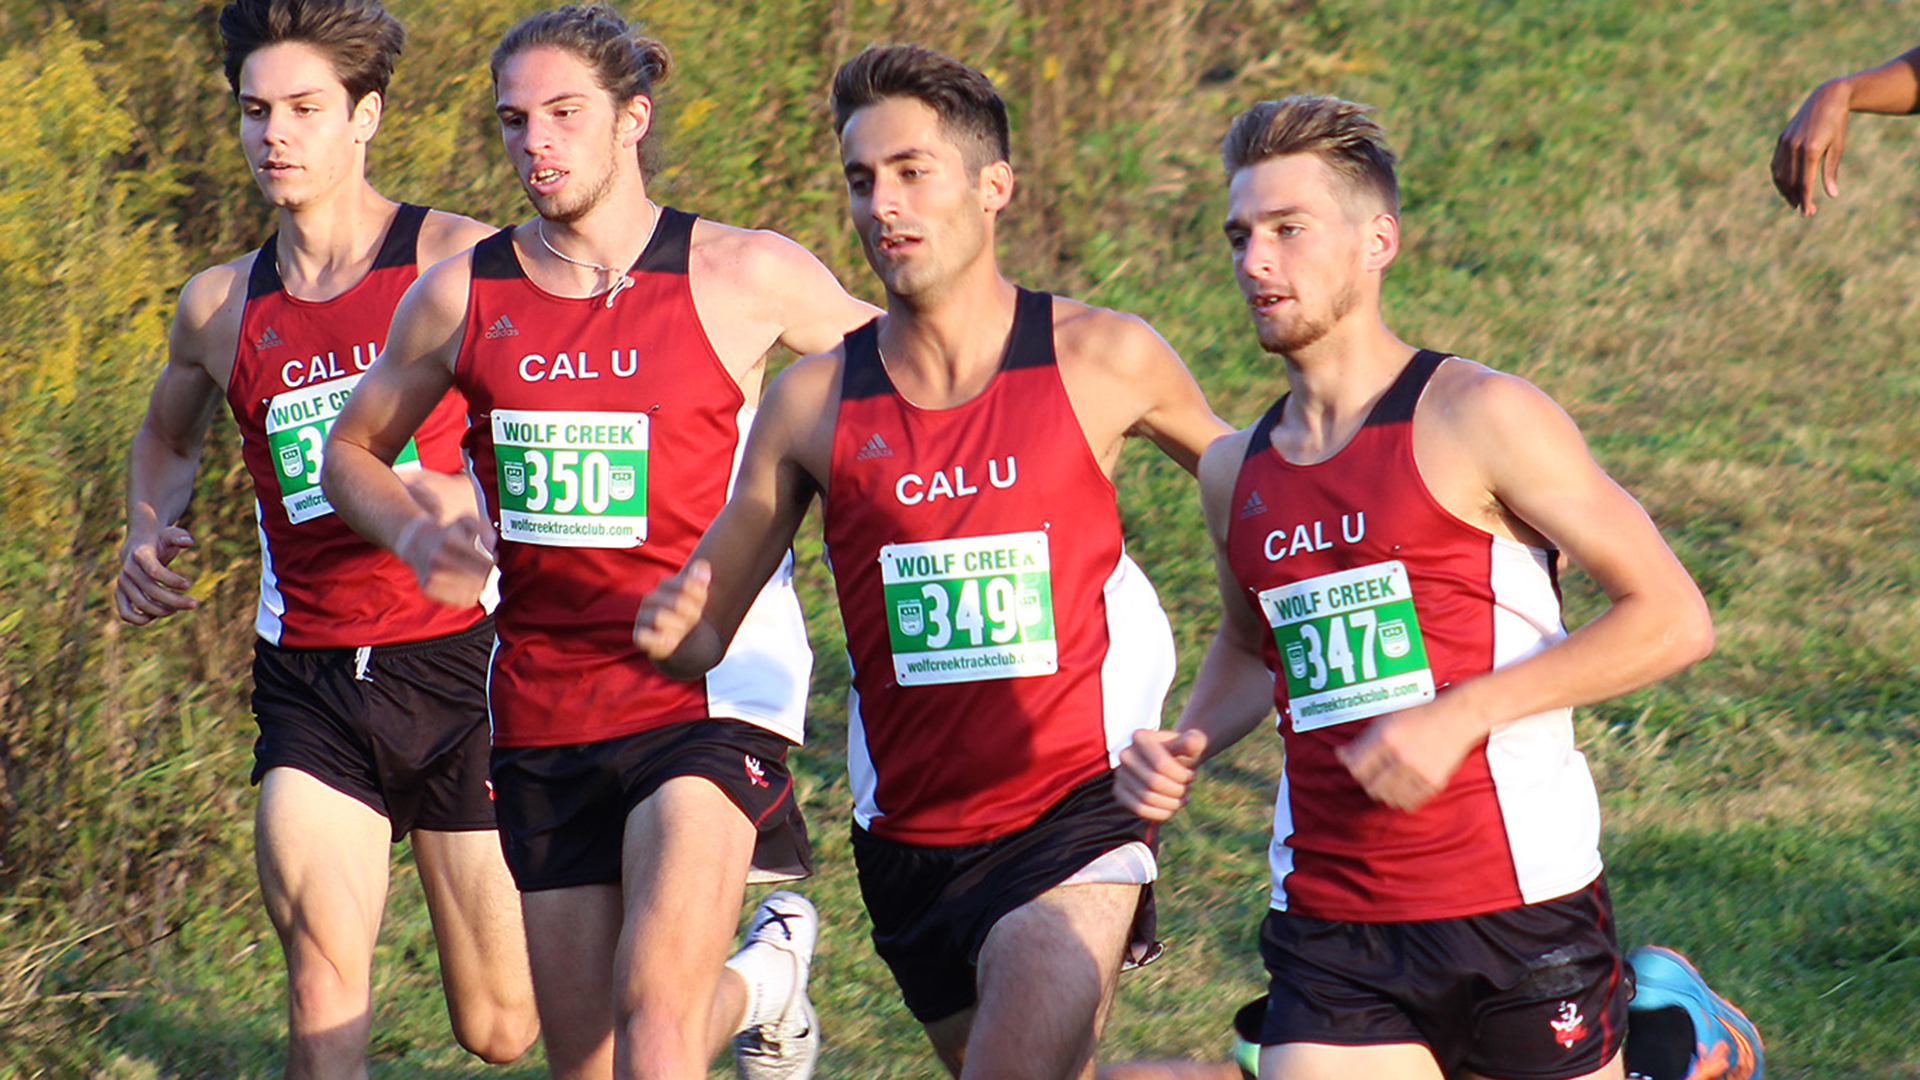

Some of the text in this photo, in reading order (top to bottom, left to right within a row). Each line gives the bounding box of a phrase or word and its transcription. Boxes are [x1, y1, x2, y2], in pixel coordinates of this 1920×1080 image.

[485, 328, 519, 339] adidas
[281, 342, 378, 388] CAL U
[518, 349, 638, 382] CAL U
[272, 396, 324, 426] WOLF
[503, 421, 634, 445] WOLF CREEK
[296, 420, 336, 485] 3
[523, 449, 611, 515] 350
[895, 456, 1017, 505] CAL U
[509, 517, 634, 536] wolfcreektrackclub.com
[1264, 511, 1366, 562] CAL U
[896, 553, 955, 578] WOLF
[920, 576, 1018, 649] 349
[1274, 575, 1396, 621] WOLF CREEK
[1299, 608, 1379, 691] 347
